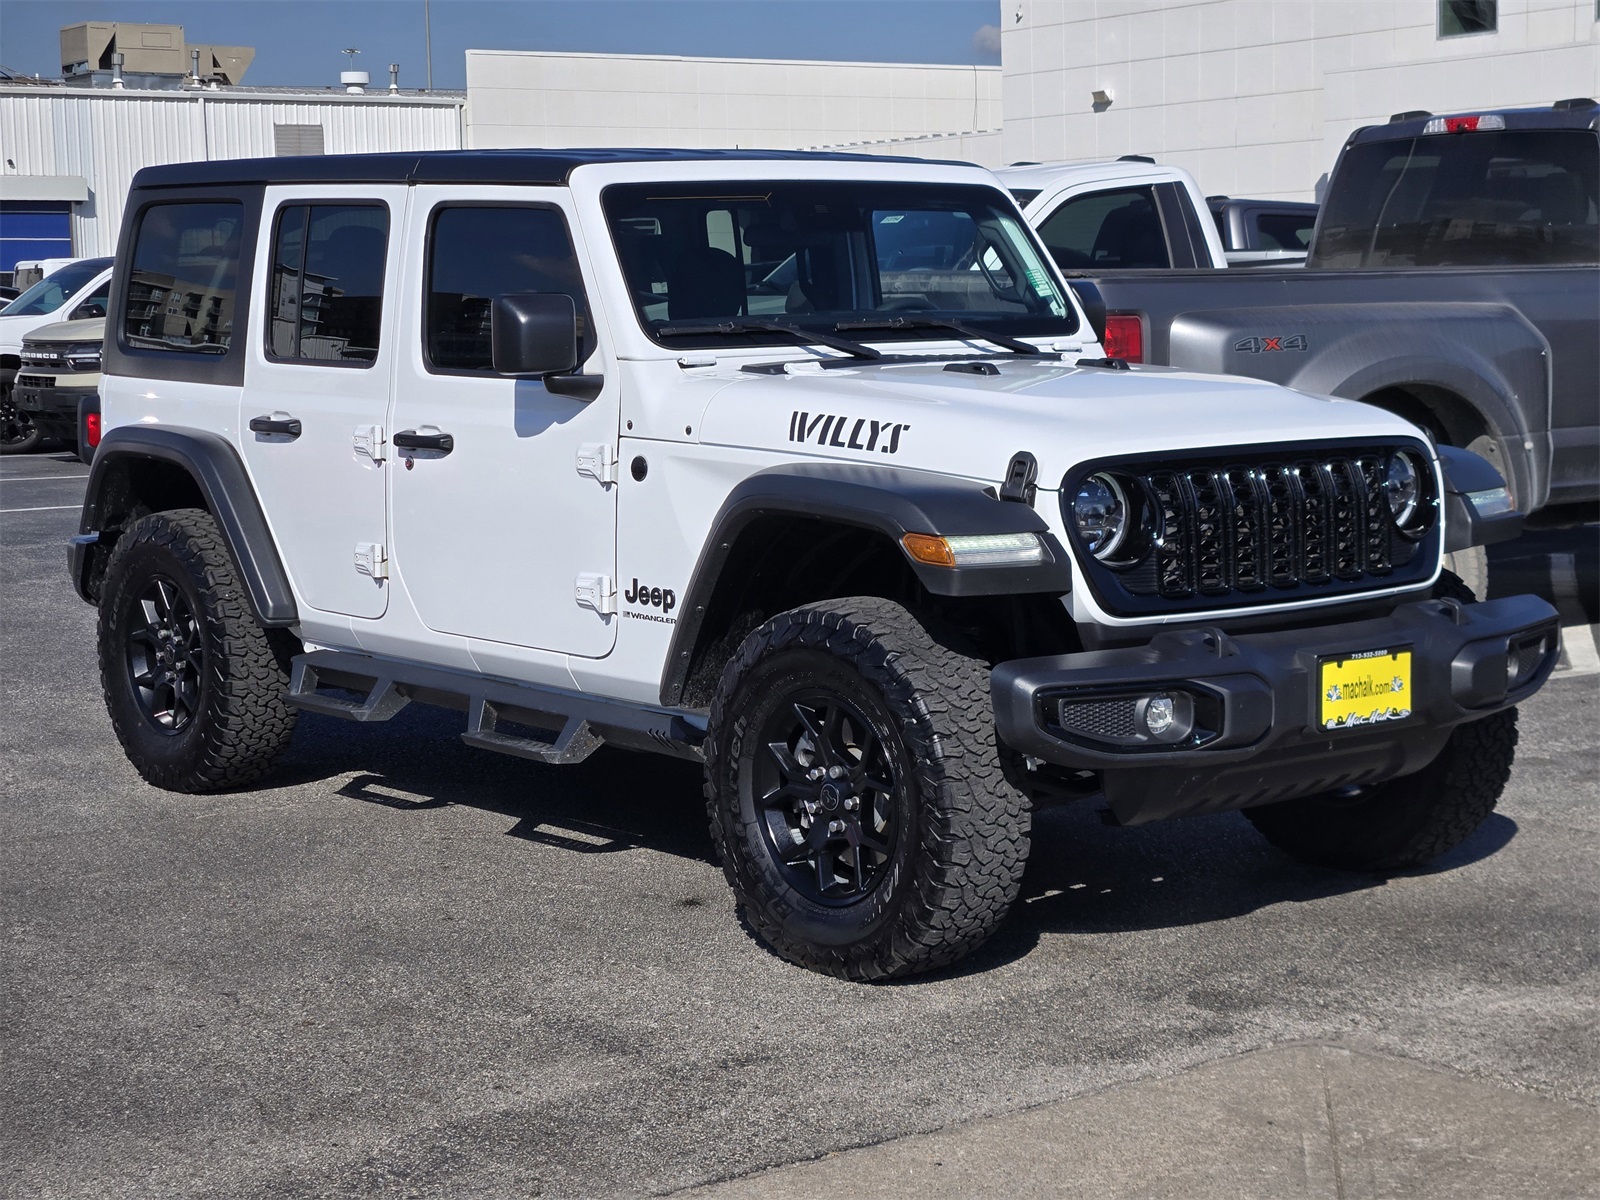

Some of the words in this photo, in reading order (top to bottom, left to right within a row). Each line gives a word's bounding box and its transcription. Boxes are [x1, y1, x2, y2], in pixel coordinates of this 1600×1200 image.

[788, 410, 911, 454] WILLYS
[624, 577, 676, 614] Jeep
[630, 611, 677, 624] WRANGLER
